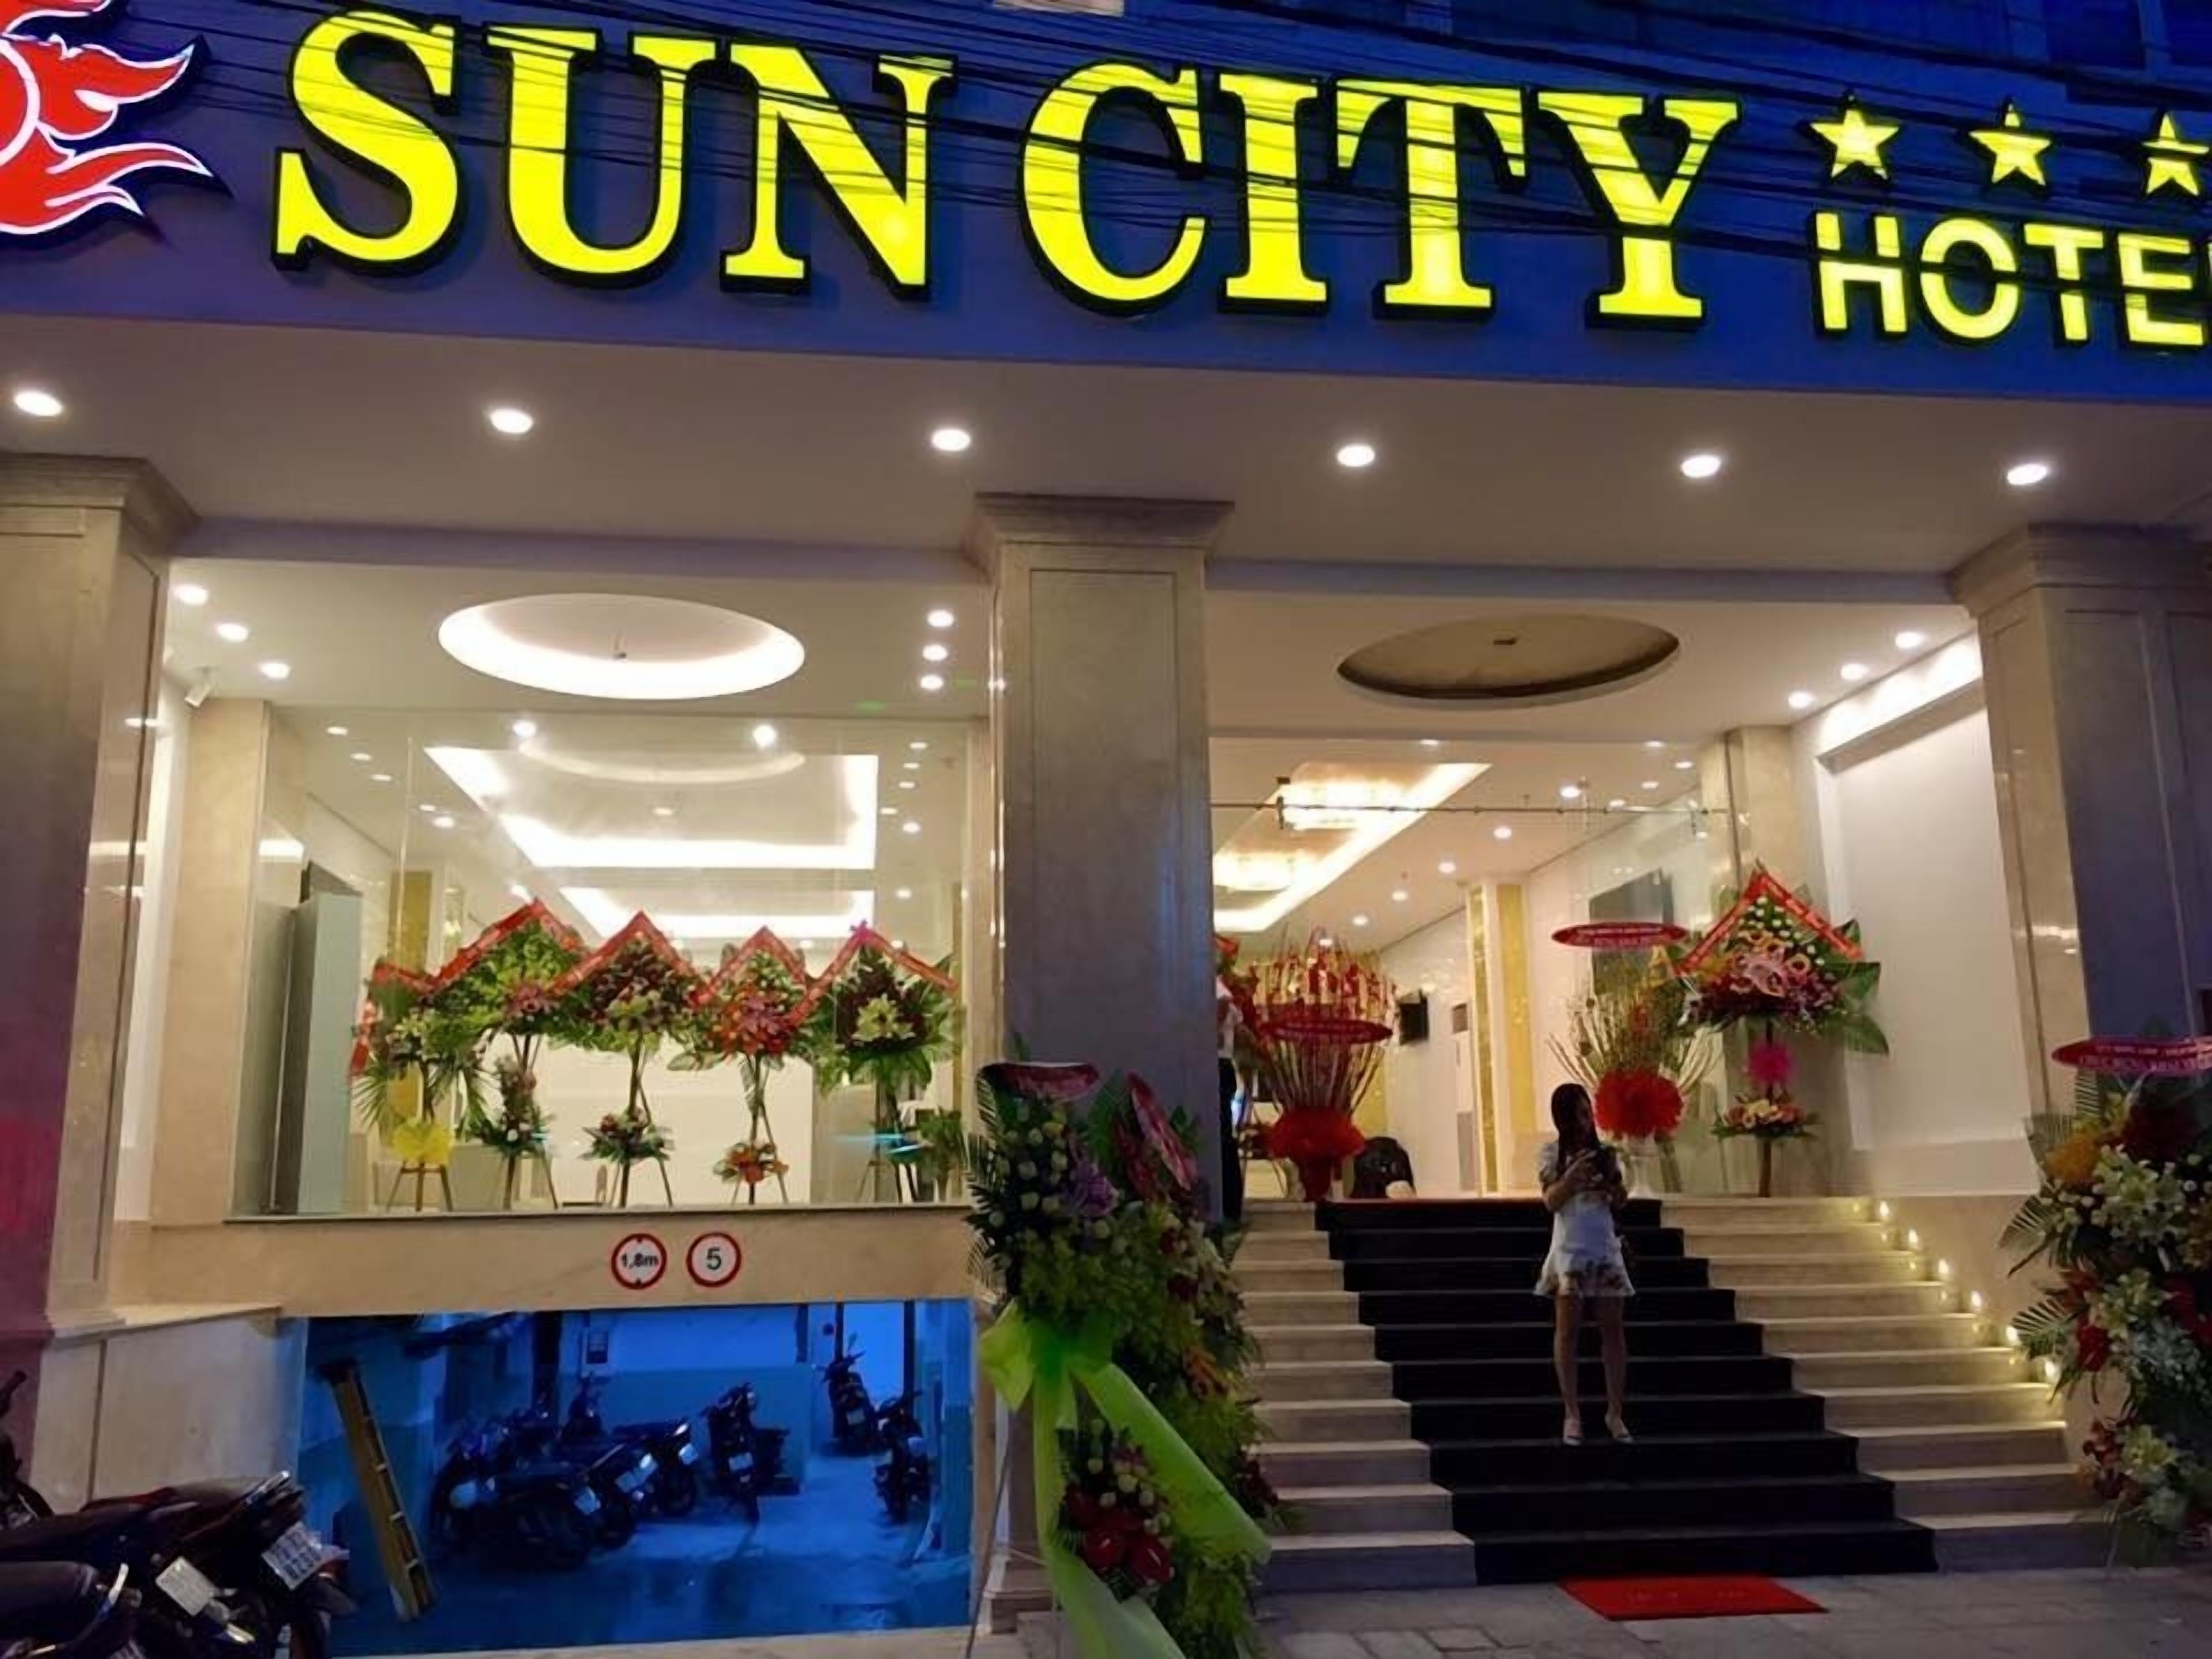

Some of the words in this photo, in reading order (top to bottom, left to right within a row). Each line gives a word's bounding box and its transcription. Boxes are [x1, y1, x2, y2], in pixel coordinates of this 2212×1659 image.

[278, 12, 949, 284] SUN
[1024, 65, 1736, 316] CITY
[1817, 213, 2212, 344] HOTE
[706, 1247, 721, 1270] 5
